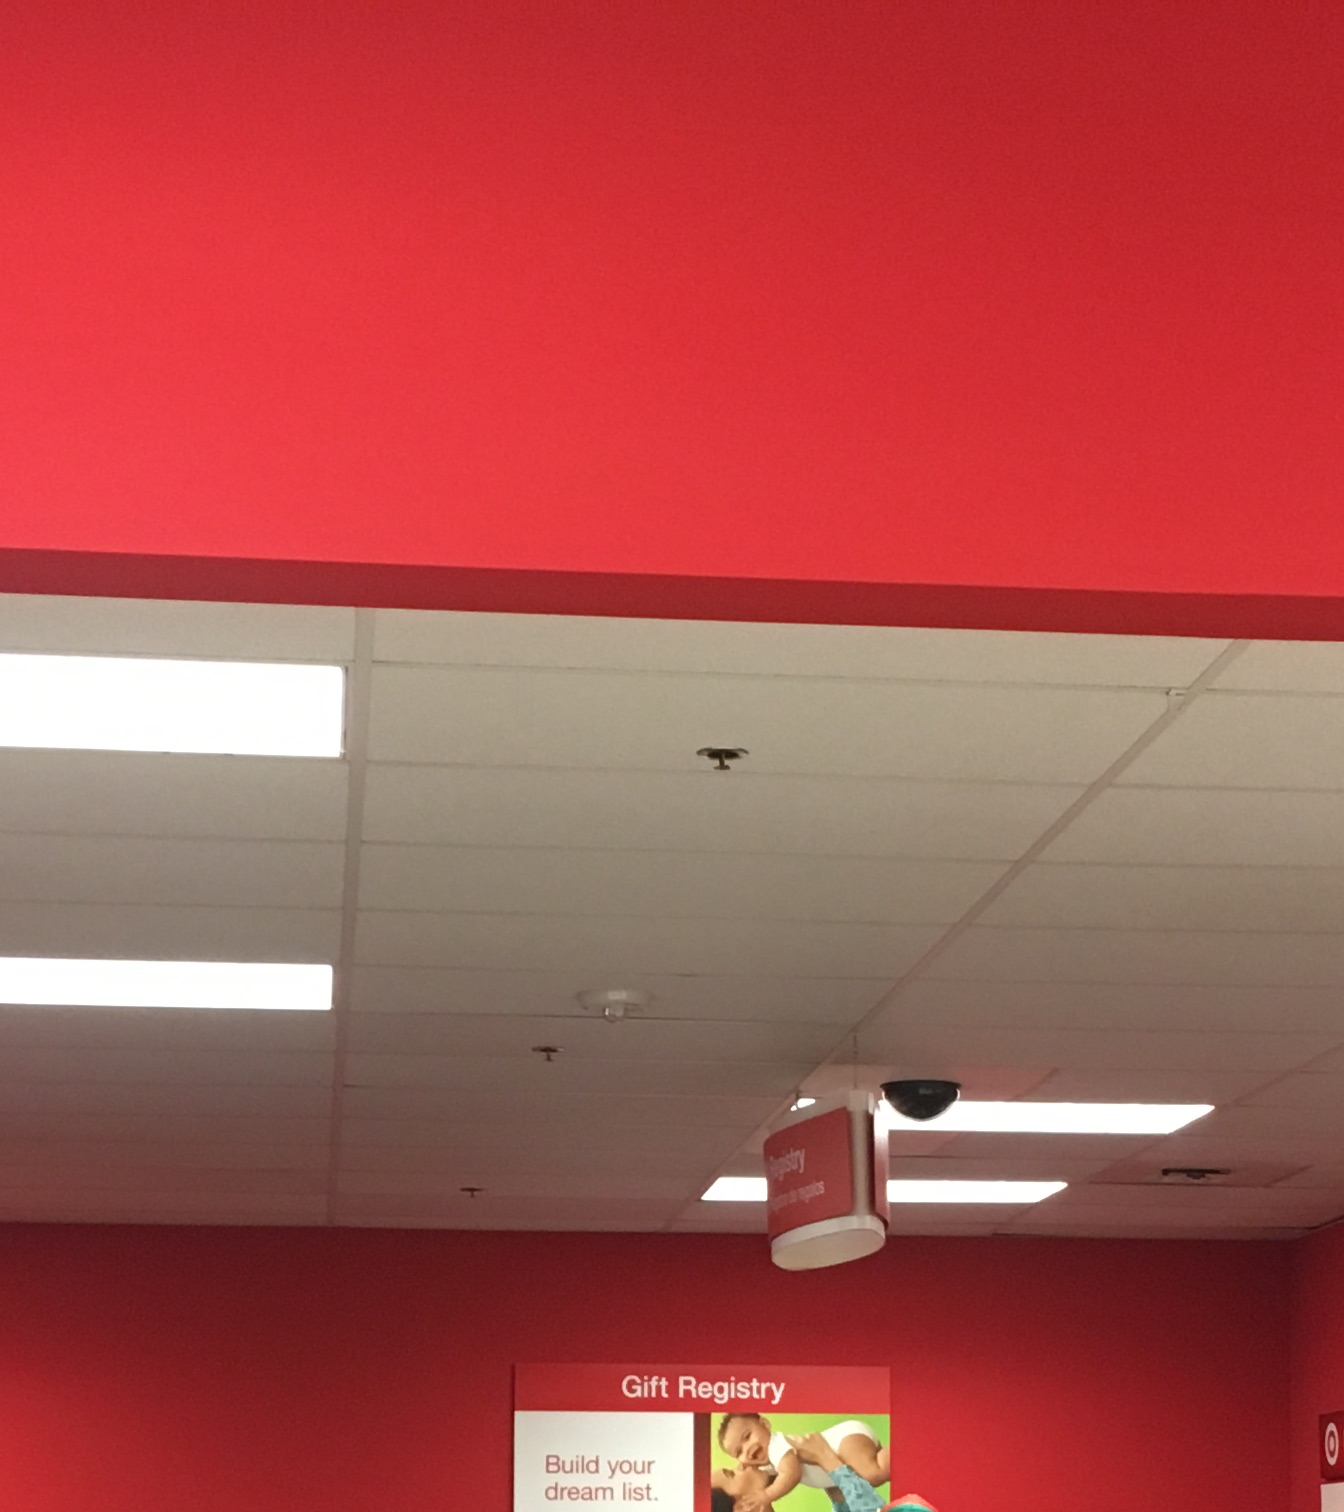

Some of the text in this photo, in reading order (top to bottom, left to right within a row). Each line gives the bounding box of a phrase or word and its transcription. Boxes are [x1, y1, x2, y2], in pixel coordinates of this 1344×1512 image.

[621, 1375, 785, 1405] Gift Registry
[545, 1454, 656, 1479] Build your
[544, 1481, 658, 1501] dream list.
